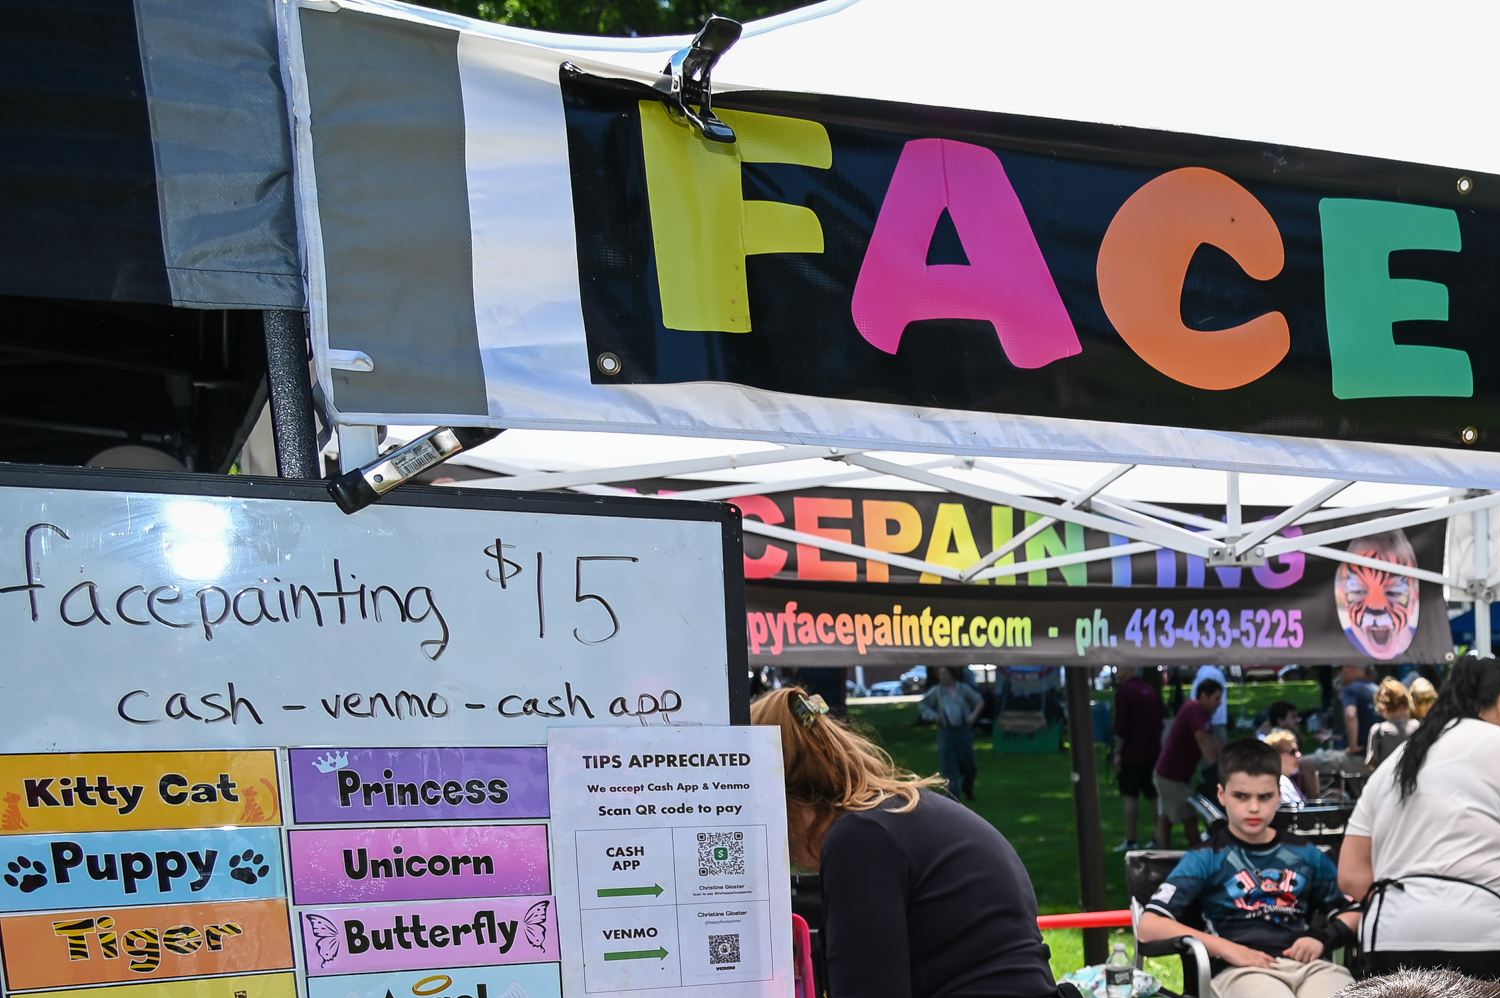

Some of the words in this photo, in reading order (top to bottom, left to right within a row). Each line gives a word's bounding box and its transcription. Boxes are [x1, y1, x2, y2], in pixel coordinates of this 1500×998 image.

[638, 98, 1474, 399] FACE
[0, 524, 450, 660] facepainting
[484, 538, 641, 645] $15
[1075, 608, 1118, 657] ph.
[1124, 608, 1304, 649] 413-433-5225
[118, 683, 264, 725] cash
[322, 688, 448, 719] venmo
[498, 683, 596, 720] cash
[609, 688, 683, 727] app
[582, 754, 622, 769] TIPS
[628, 754, 751, 768] APPRECIATED
[24, 777, 144, 810] Kitty
[158, 772, 240, 805] Cat
[337, 769, 510, 809] Princess
[587, 783, 606, 793] We
[610, 783, 645, 794] accept
[647, 782, 673, 792] Cash
[677, 782, 698, 793] App
[702, 782, 709, 790] &
[712, 781, 750, 791] Venmo
[599, 805, 631, 816] Scan
[635, 805, 656, 815] QR
[661, 804, 694, 814] code
[698, 805, 711, 813] to
[716, 805, 742, 815] pay
[49, 841, 219, 895] Puppy
[343, 846, 495, 880] Unicorn
[606, 846, 644, 857] CASH
[612, 860, 640, 872] APP
[53, 915, 245, 974] Tiger
[344, 911, 519, 955] Butterfly
[603, 927, 658, 940] VENMO
